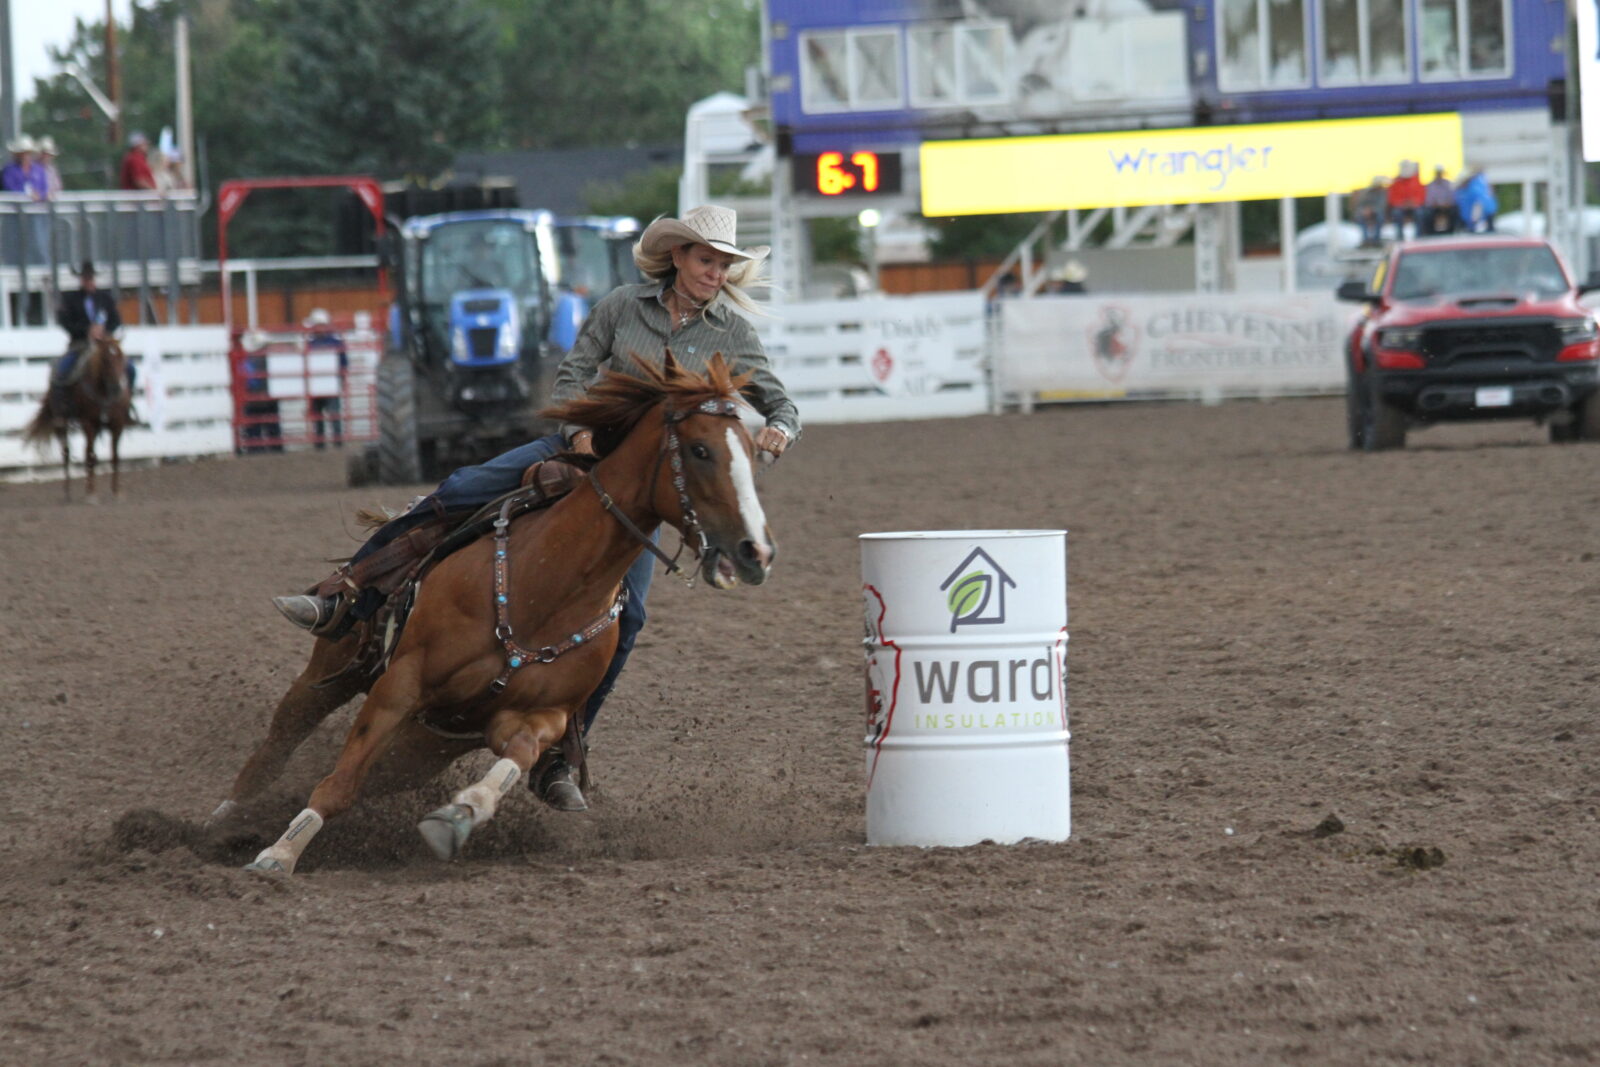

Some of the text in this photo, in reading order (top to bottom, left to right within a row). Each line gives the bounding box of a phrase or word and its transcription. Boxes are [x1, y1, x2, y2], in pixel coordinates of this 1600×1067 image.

[1107, 142, 1274, 192] Wrangler
[1147, 309, 1338, 345] CHEYENNE
[914, 646, 1054, 704] ward
[914, 711, 1055, 729] INSULATION
